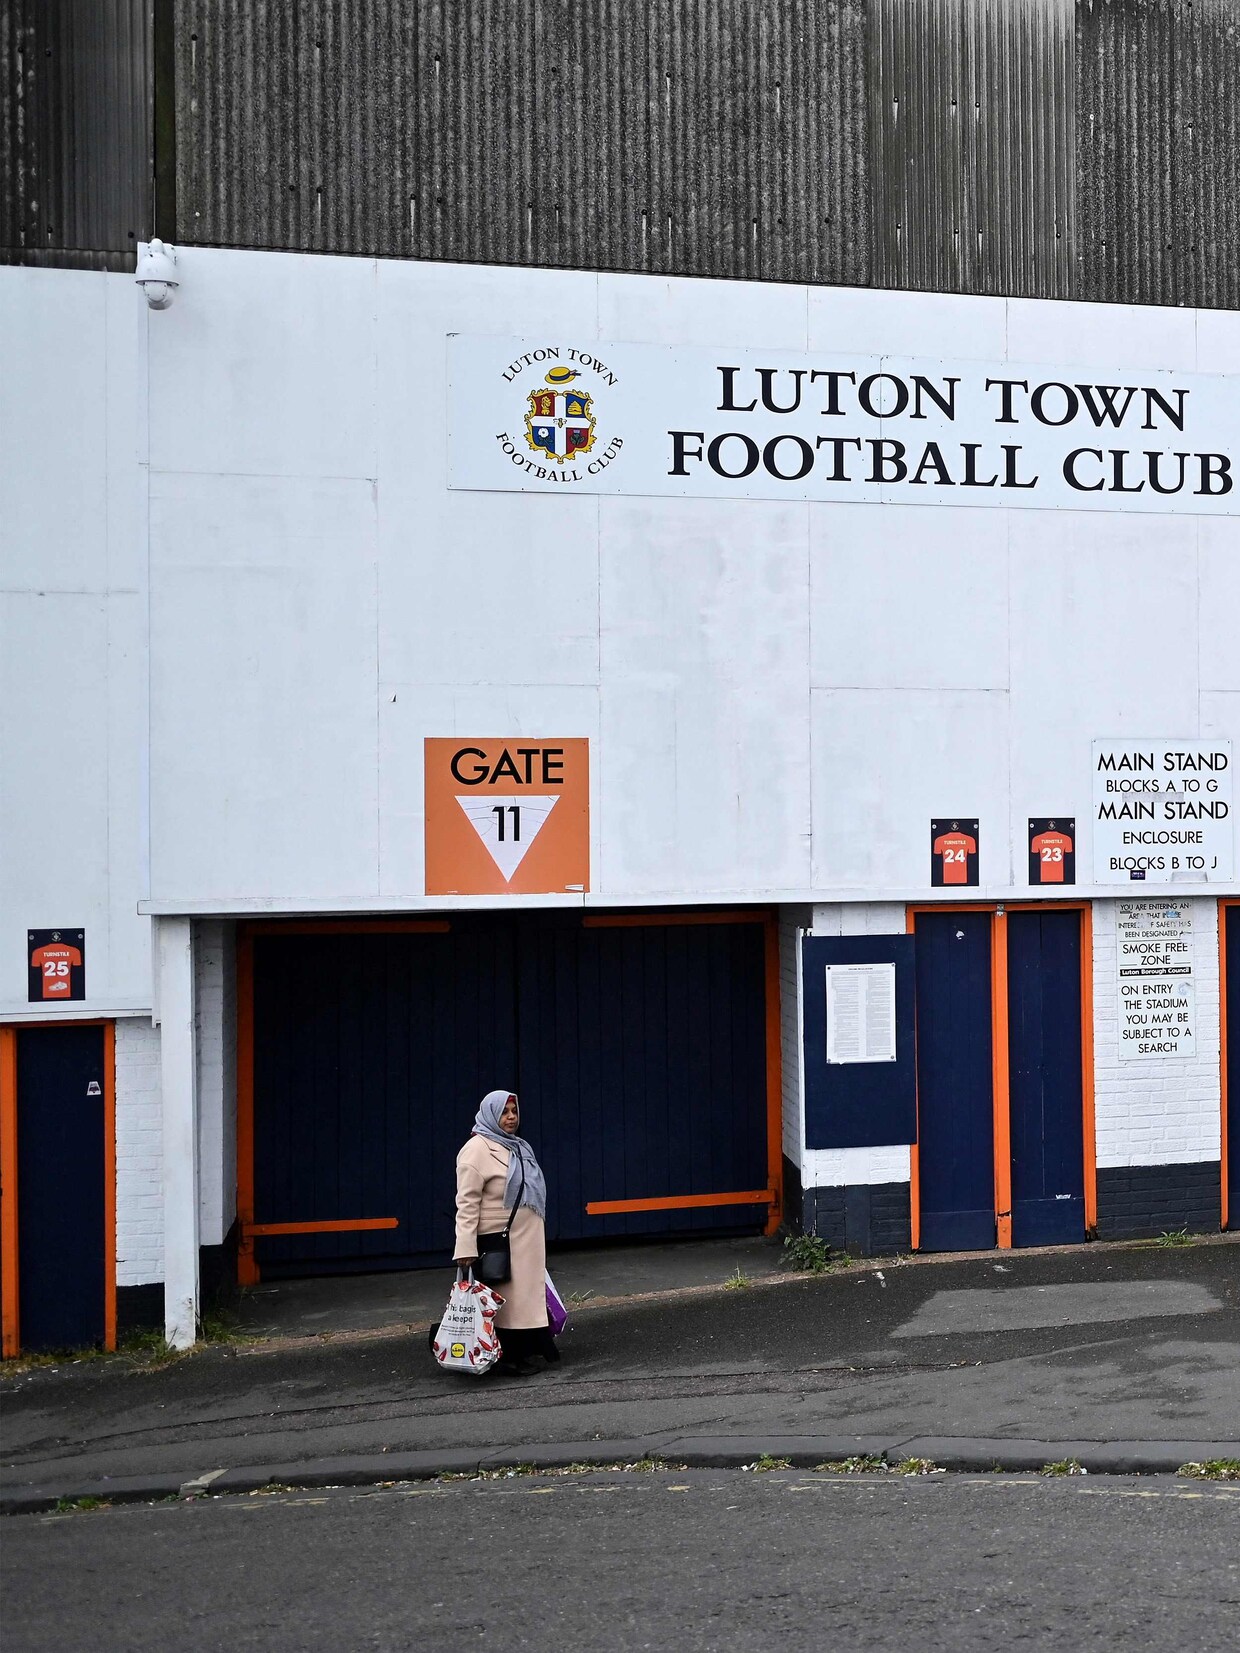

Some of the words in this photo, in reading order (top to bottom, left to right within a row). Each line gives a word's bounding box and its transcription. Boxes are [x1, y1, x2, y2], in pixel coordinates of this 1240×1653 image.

[501, 347, 560, 383] LUTON
[568, 348, 618, 387] TOWN
[716, 365, 961, 421] LUTON
[984, 378, 1190, 432] TOWN
[496, 432, 582, 482] FOOTBALL
[588, 436, 624, 474] CLUB
[667, 429, 1038, 488] FOOTBALL
[1063, 447, 1234, 496] CLUB
[450, 747, 564, 786] GATE
[1098, 752, 1154, 772] MAIN
[1163, 752, 1228, 772] STAND
[1106, 780, 1160, 792] BLOCKS
[1166, 780, 1176, 792] A
[1182, 780, 1200, 792] TO
[1206, 779, 1218, 792] G
[1098, 801, 1155, 820] MAIN
[1164, 801, 1228, 820] STAND
[492, 806, 520, 842] 11
[1122, 830, 1203, 844] ENCLOSURE
[944, 848, 966, 863] 24
[1041, 847, 1063, 862] 23
[1110, 857, 1165, 870] BLOCKS
[1172, 856, 1180, 869] B
[1186, 856, 1204, 869] TO
[1211, 856, 1217, 869] J
[1122, 943, 1161, 954] SMOKE
[1165, 942, 1188, 952] FREE
[1141, 955, 1171, 965] ZONE
[44, 961, 69, 977] 25
[1121, 986, 1138, 996] ON
[1143, 984, 1173, 995] ENTRY
[1124, 1000, 1142, 1010] THE
[1146, 998, 1188, 1009] STADIUM
[1126, 1014, 1148, 1025] YOU
[1152, 1013, 1173, 1023] MAY
[1178, 1013, 1188, 1022] BE
[1122, 1028, 1163, 1040] SUBJECT
[1167, 1028, 1180, 1037] TO
[1184, 1028, 1192, 1036] A
[1138, 1042, 1177, 1054] SEARCH
